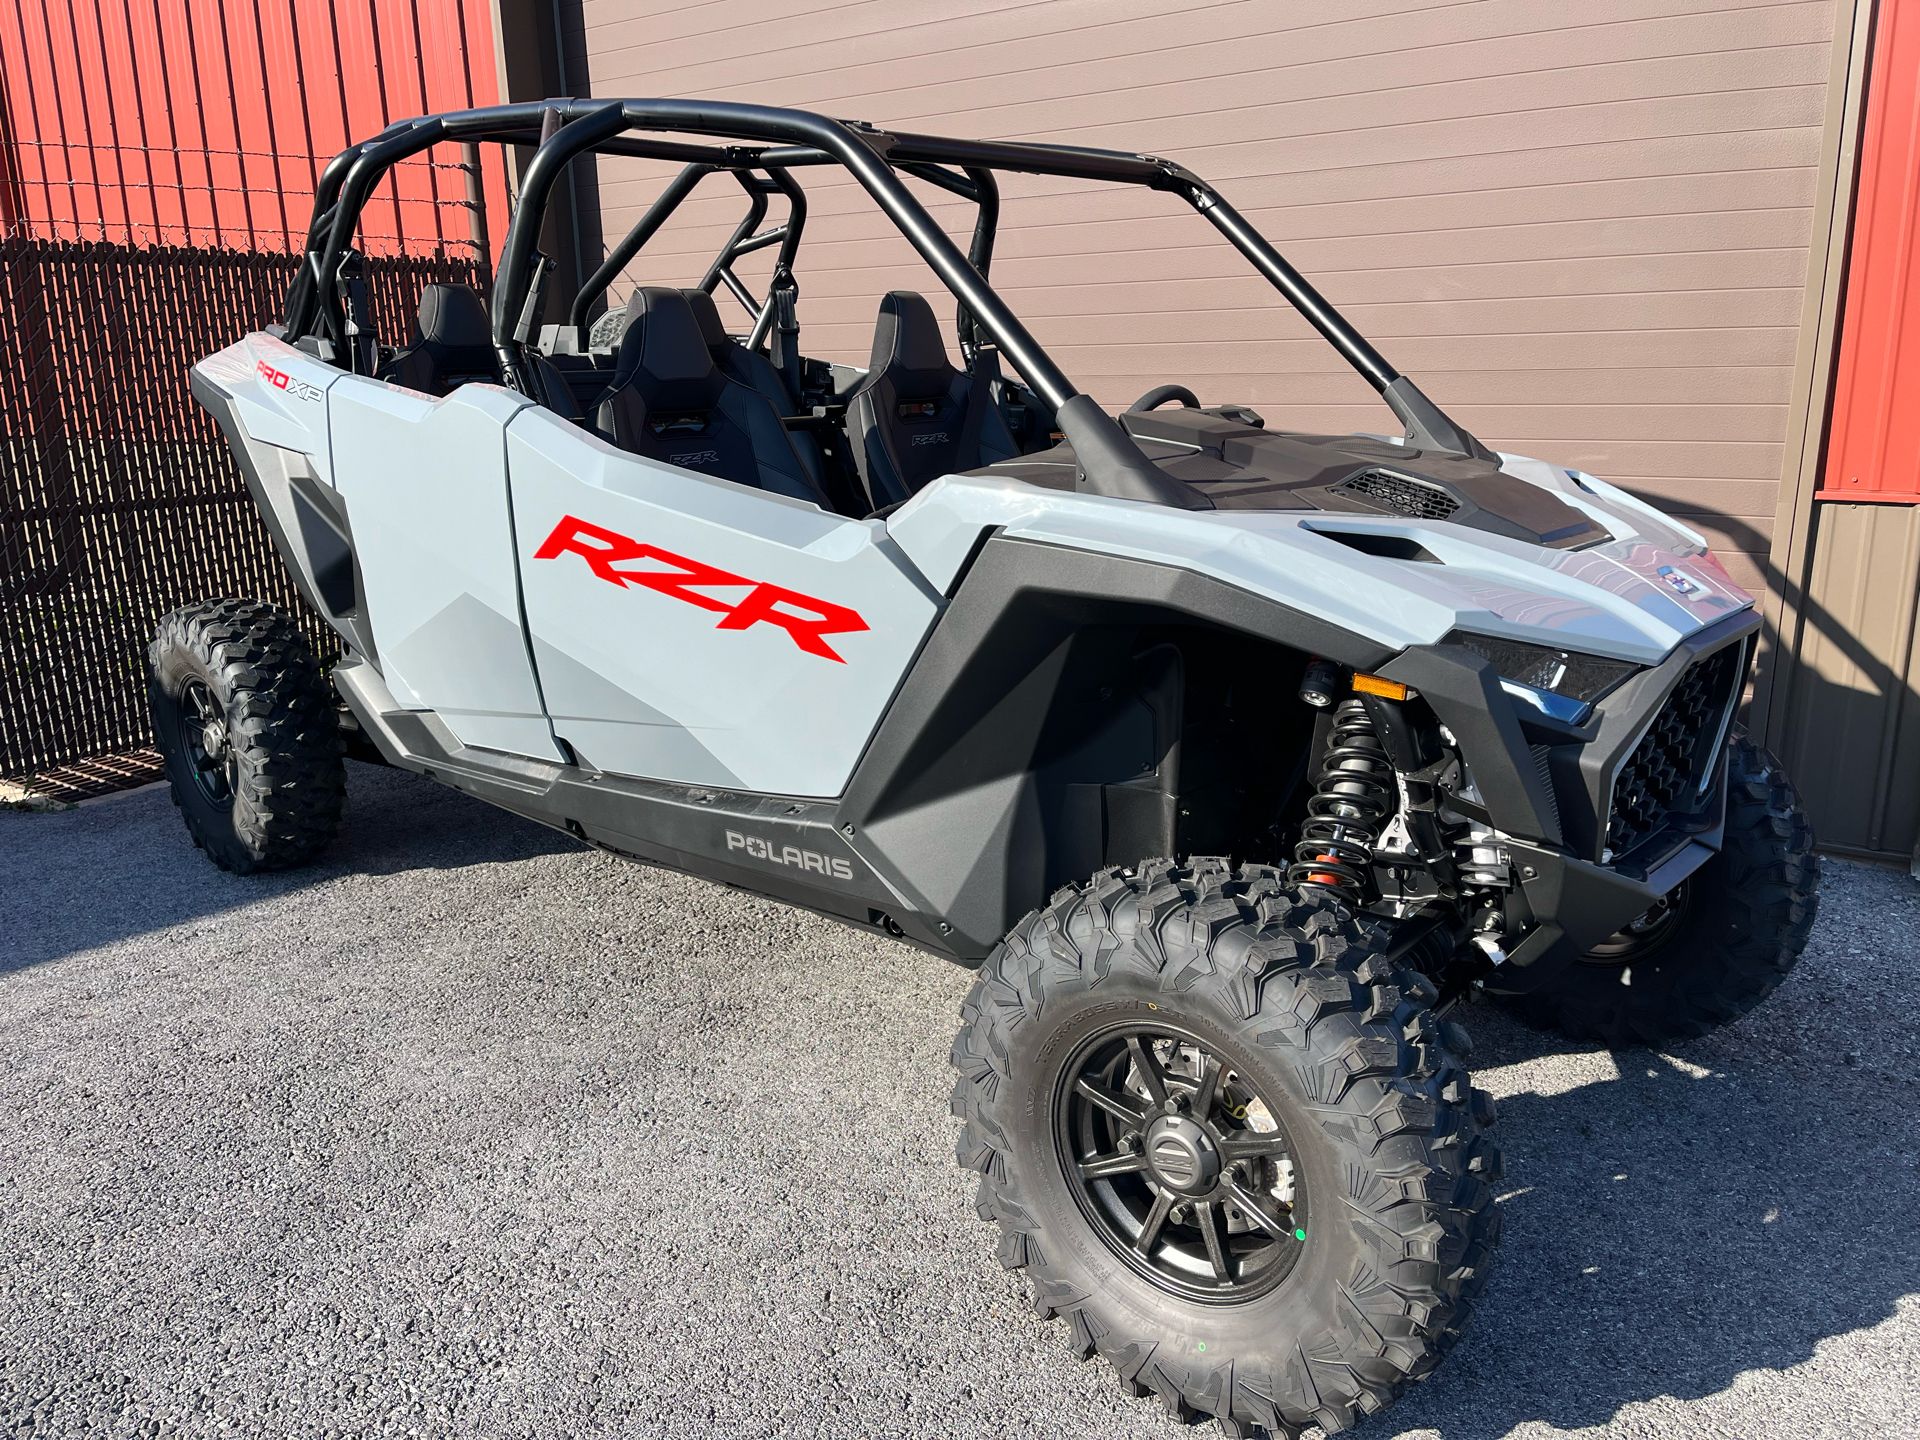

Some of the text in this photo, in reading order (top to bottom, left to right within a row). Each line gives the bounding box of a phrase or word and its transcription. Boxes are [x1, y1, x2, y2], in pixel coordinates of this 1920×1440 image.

[911, 432, 950, 446] RZR
[669, 450, 720, 466] RZR
[533, 514, 872, 665] RZR
[725, 830, 854, 881] POLARIS
